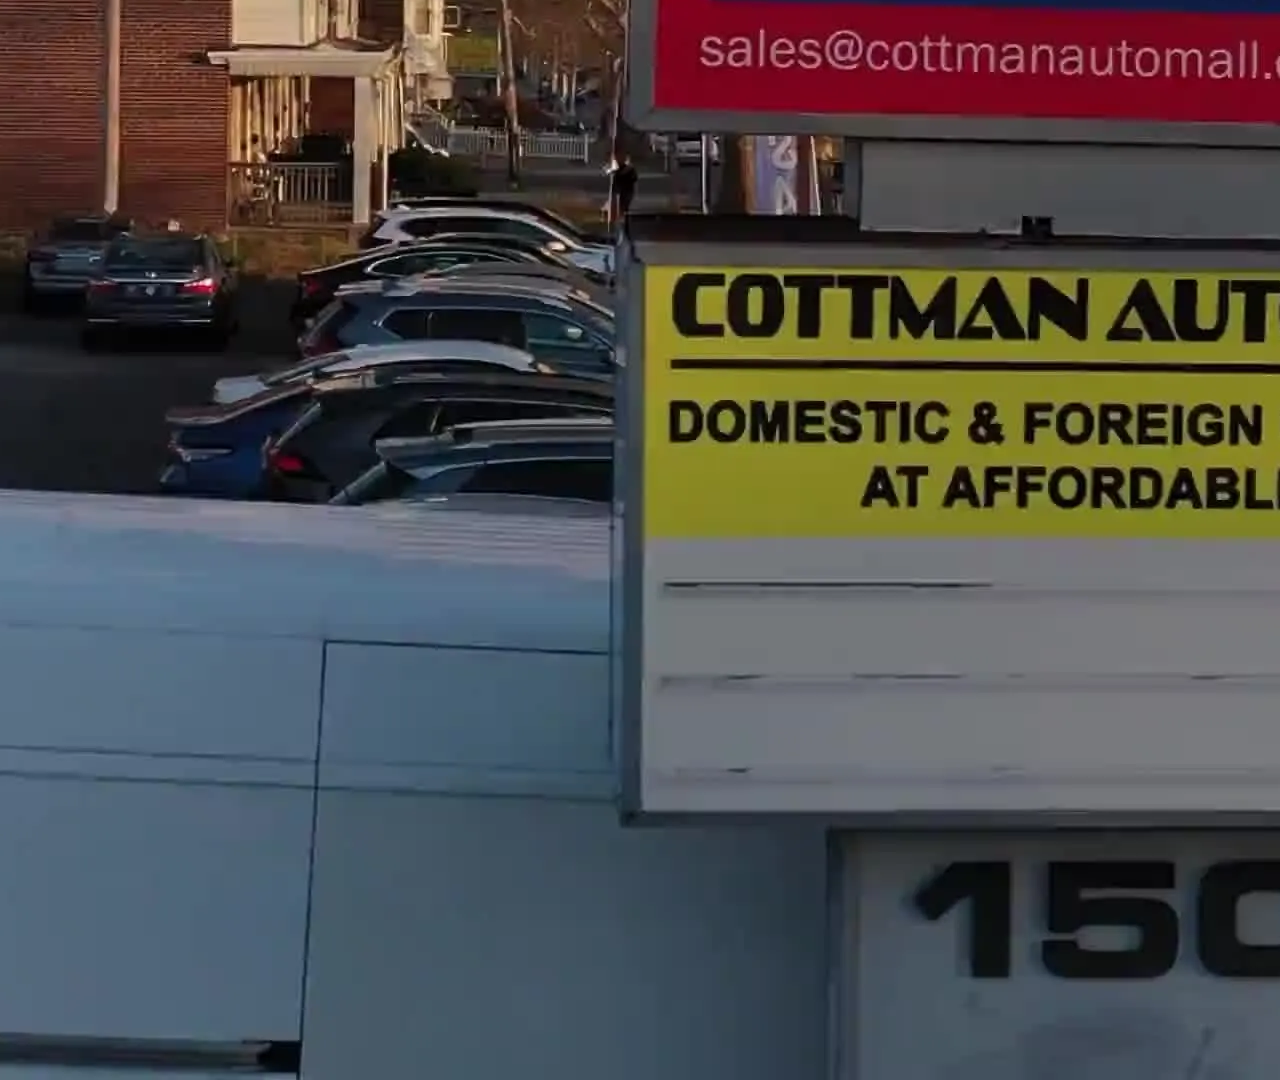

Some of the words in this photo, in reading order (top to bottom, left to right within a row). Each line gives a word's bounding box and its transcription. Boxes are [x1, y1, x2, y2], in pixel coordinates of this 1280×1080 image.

[671, 273, 1089, 342] COTTMAN
[668, 399, 951, 445] DOMESTIC
[967, 400, 1006, 445] &
[1023, 401, 1263, 447] FOREIGN
[860, 466, 929, 509] AT
